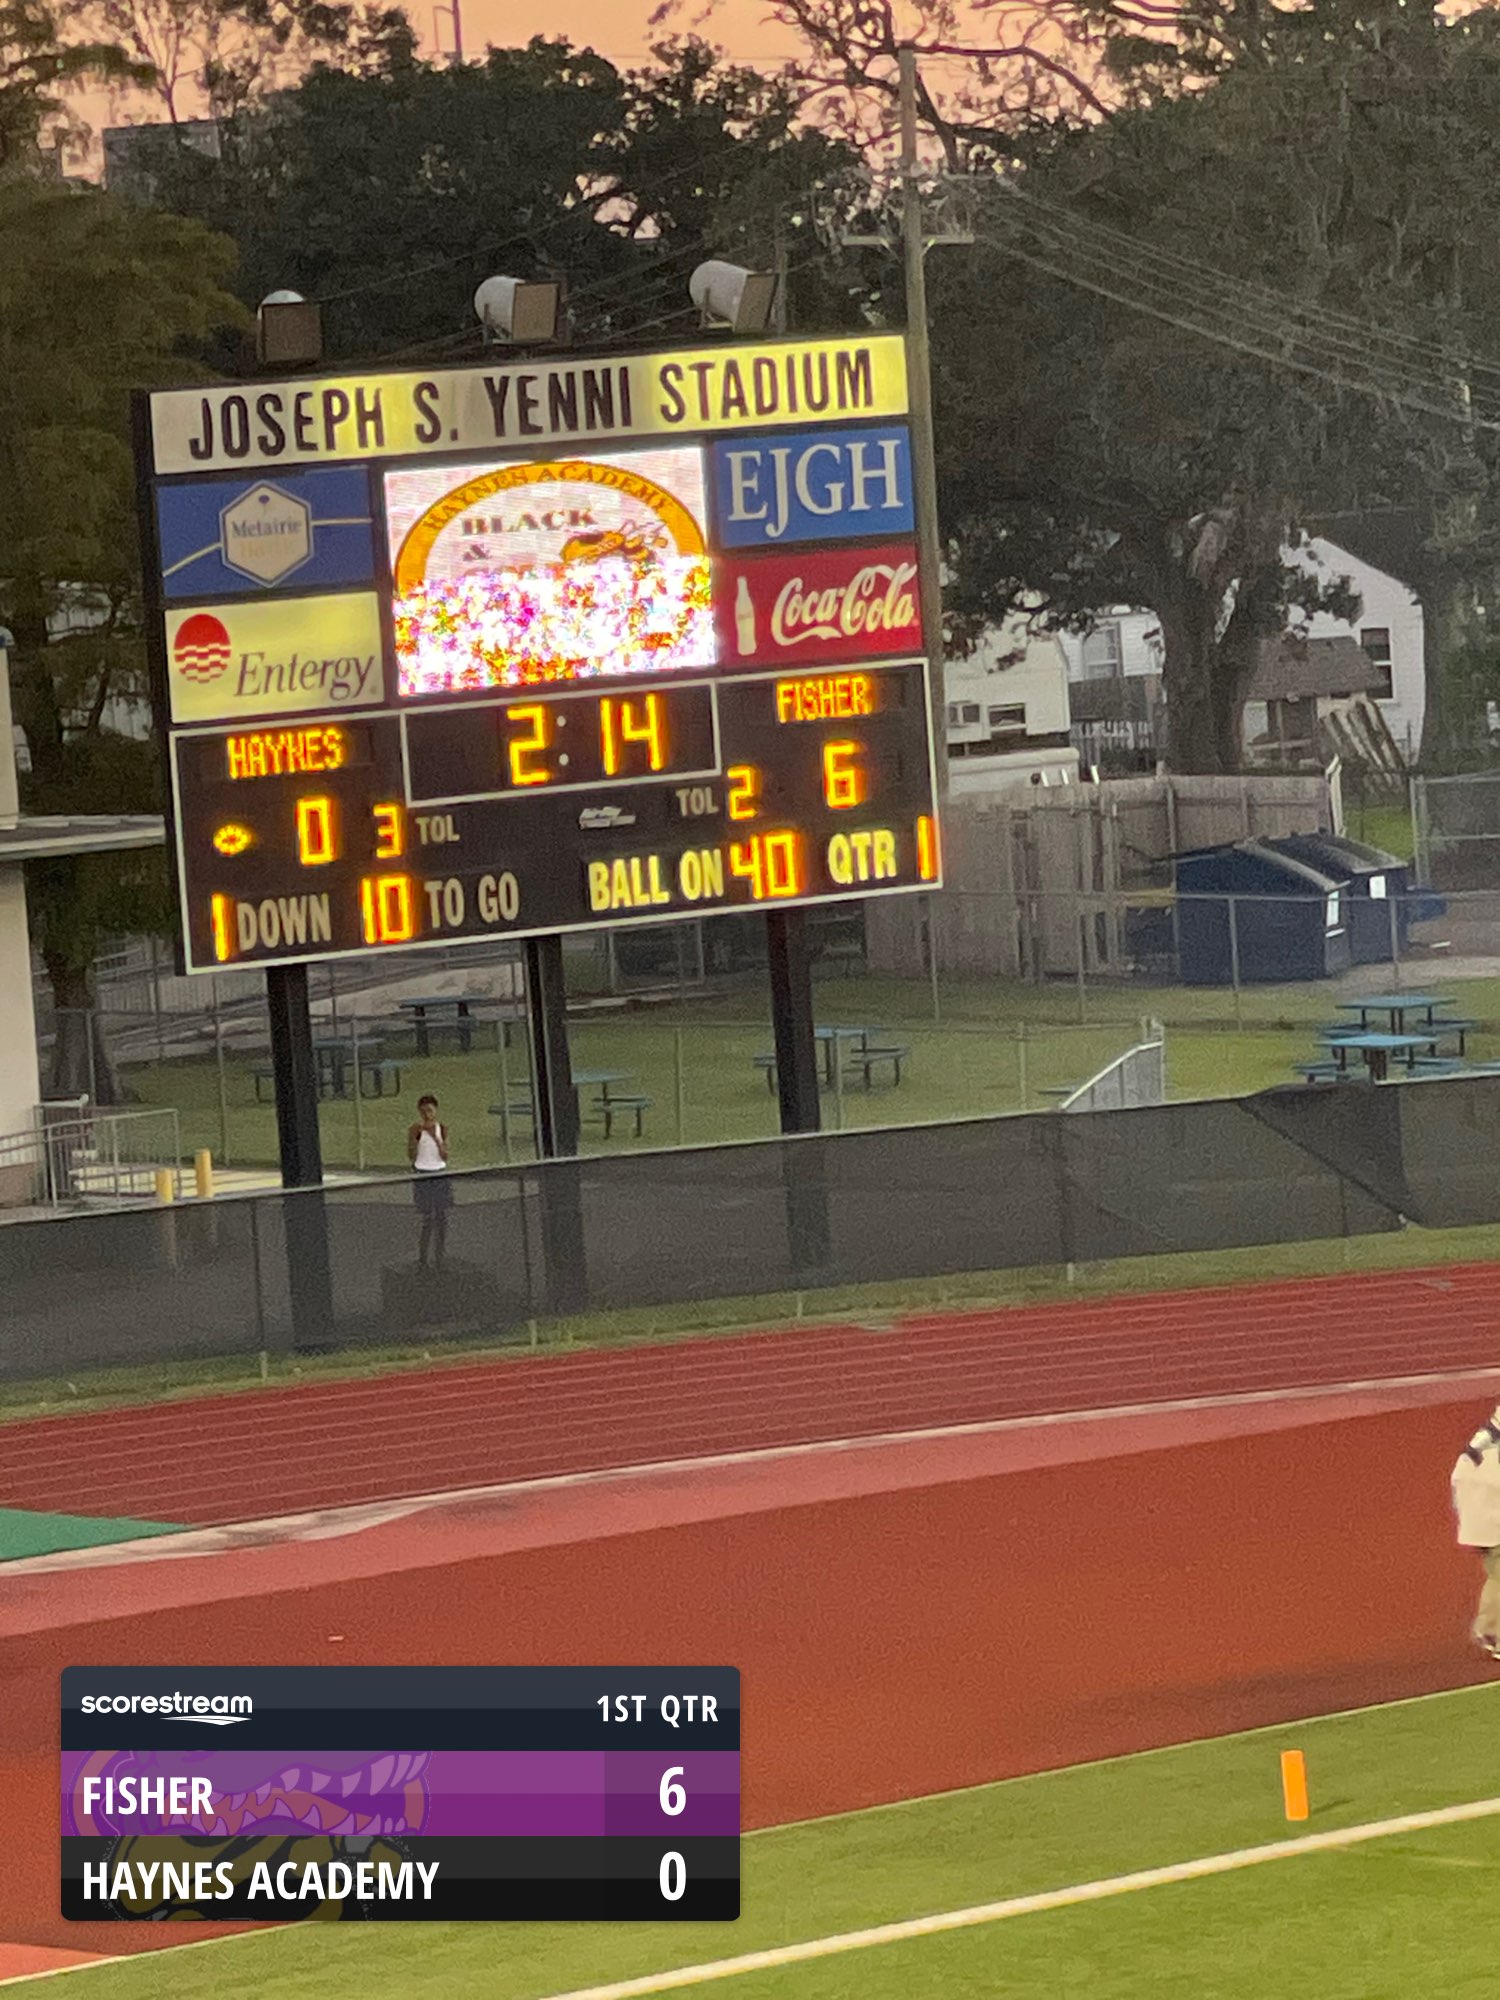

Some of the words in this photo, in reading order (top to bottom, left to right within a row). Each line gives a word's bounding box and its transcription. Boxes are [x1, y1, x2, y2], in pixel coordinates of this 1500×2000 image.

[189, 389, 386, 461] JOSEPH
[413, 382, 460, 443] S.
[483, 366, 632, 437] YENNI
[659, 348, 874, 423] STADIUM
[461, 509, 597, 536] BLACK
[538, 464, 669, 512] ACADEMY
[725, 440, 904, 538] EJGH
[231, 517, 302, 538] Metairie
[770, 562, 917, 646] Coca-Cola
[234, 650, 375, 704] Entergy
[775, 672, 873, 724] FISHER
[226, 726, 344, 780] HAYNES
[822, 739, 859, 809] 6
[676, 787, 718, 817] TOL
[726, 764, 758, 821] 2
[296, 796, 337, 865] 0
[372, 802, 403, 859] 3
[416, 814, 460, 845] TOL
[827, 829, 897, 884] QTR
[916, 815, 936, 881] 1
[588, 855, 670, 911] BALL
[679, 849, 725, 900] ON
[729, 832, 801, 899] 40
[211, 891, 231, 962] 1
[237, 893, 332, 950] DOWN
[360, 874, 415, 945] 10
[424, 878, 465, 929] TO
[478, 871, 520, 922] GO
